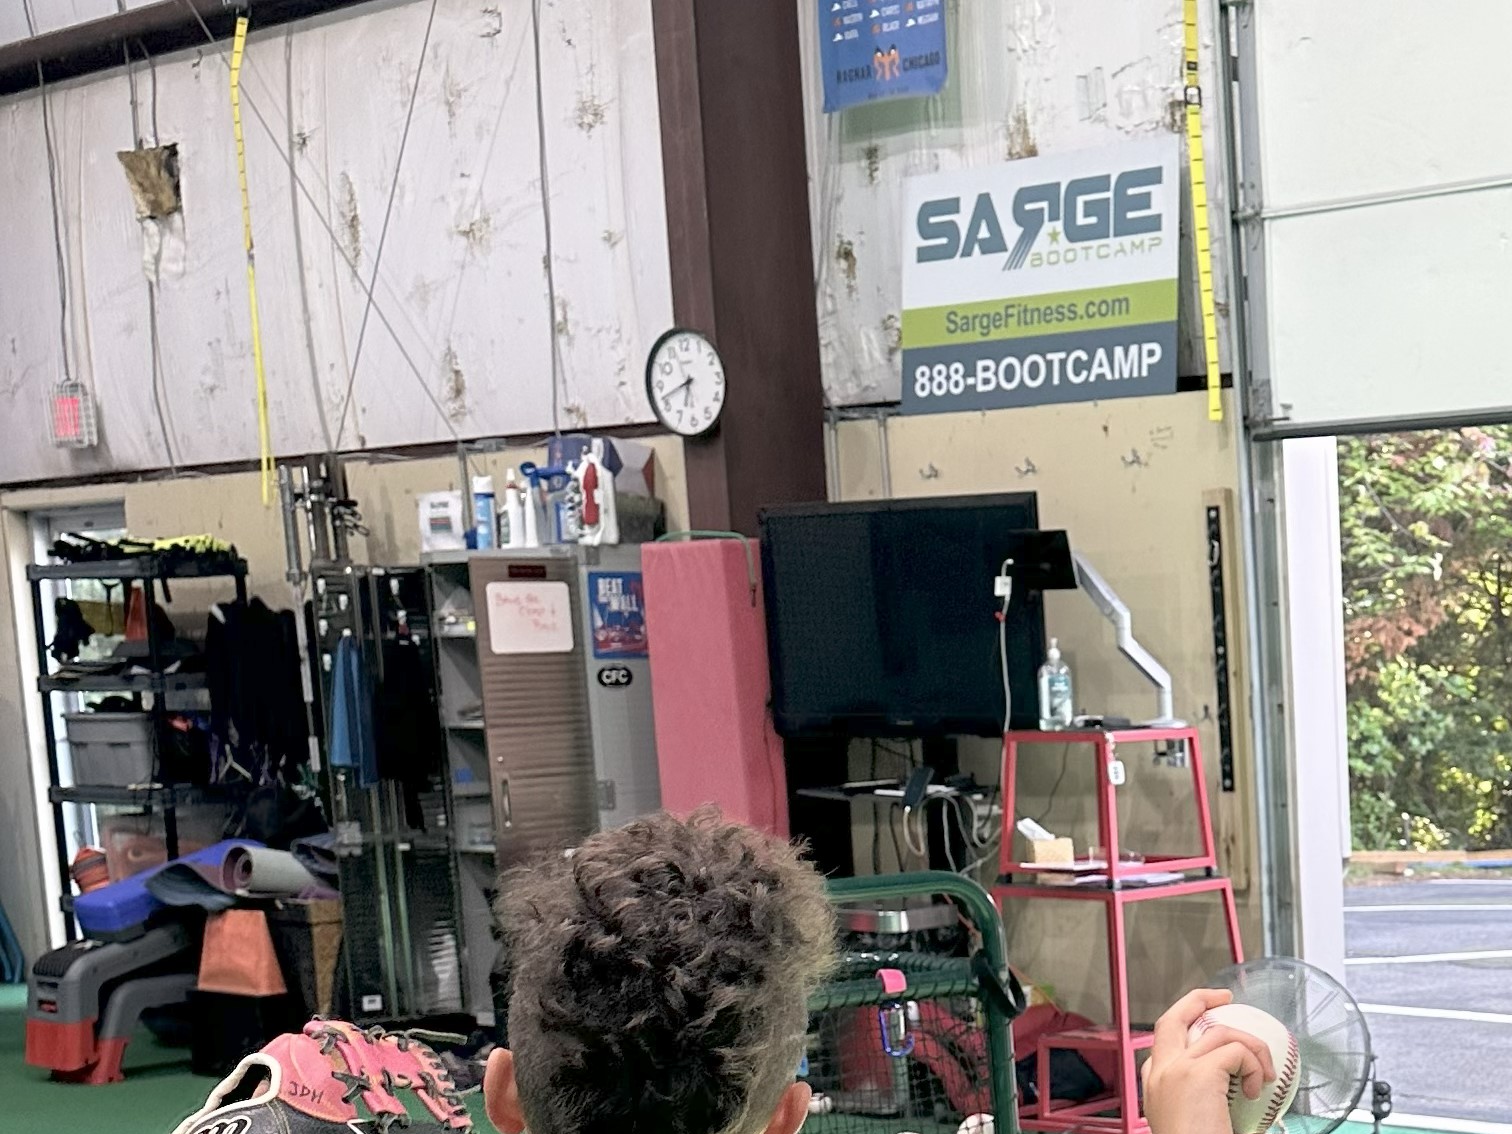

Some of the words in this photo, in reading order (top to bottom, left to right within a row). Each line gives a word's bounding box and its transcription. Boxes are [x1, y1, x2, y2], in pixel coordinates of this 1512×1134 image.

[902, 50, 940, 71] CHICAGO
[916, 165, 1163, 272] SARGE
[1030, 236, 1163, 268] BOOTCAMP
[945, 296, 1130, 337] SargeFitness.com
[679, 337, 690, 352] 12
[707, 352, 715, 366] 2
[914, 341, 1162, 398] 888-BOOTCAMP
[676, 409, 683, 423] 7
